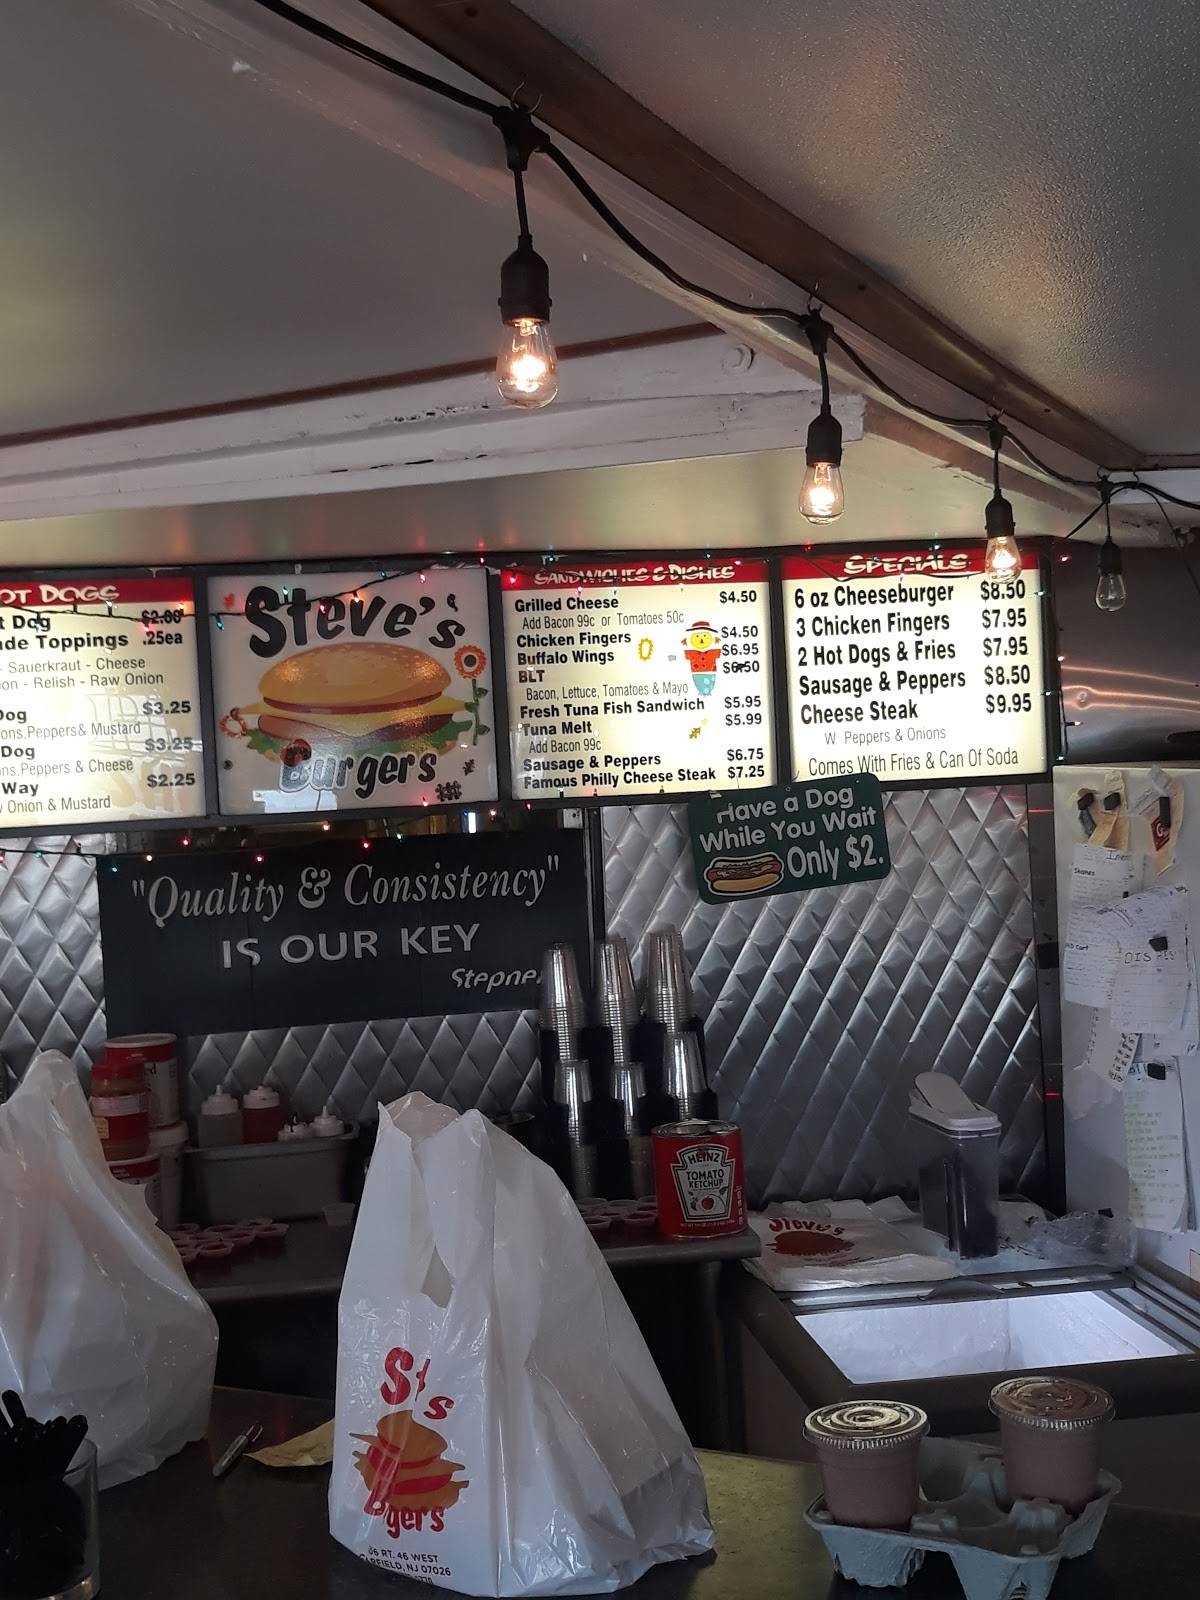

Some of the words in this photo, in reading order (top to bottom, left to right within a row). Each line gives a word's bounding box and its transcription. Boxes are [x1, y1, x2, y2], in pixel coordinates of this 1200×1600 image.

[719, 590, 757, 603] $4.50
[794, 588, 805, 608] 6
[811, 591, 828, 607] oz
[834, 584, 954, 607] Cheeseburger
[980, 579, 1026, 601] $8.50
[515, 599, 562, 613] Grilled
[569, 597, 619, 611] Cheese
[12, 614, 51, 632] Dog
[245, 585, 466, 658] Steve's
[523, 616, 542, 630] Add
[544, 615, 574, 629] Bacon
[577, 614, 595, 627] 99c
[601, 616, 610, 626] or
[617, 612, 664, 626] Tomatoes
[666, 610, 684, 624] 50c
[796, 617, 806, 637] 3
[812, 615, 881, 637] Chicken
[887, 612, 950, 636] Fingers
[981, 608, 1027, 629] $7.95
[517, 633, 575, 648] Chicken
[580, 631, 632, 647] Fingers
[721, 625, 758, 638] $4.50
[35, 631, 129, 651] Toppings
[982, 636, 1028, 658] $7.95
[518, 651, 568, 665] Buffalo
[572, 650, 615, 665] Wings
[721, 643, 759, 657] $6.95
[798, 647, 808, 667] 2
[814, 645, 842, 666] Hot
[849, 643, 890, 668] Dogs
[896, 641, 908, 662] &
[915, 640, 956, 661] Fries
[8, 659, 81, 674] Sauerkraut
[96, 657, 146, 670] Cheese
[34, 676, 75, 689] Relish
[90, 675, 120, 687] Raw
[125, 672, 164, 685] Onion
[518, 670, 545, 683] BLT
[984, 664, 1030, 686] $8.50
[526, 688, 559, 701] Bacon,
[562, 686, 599, 699] Lettuce,
[603, 684, 650, 697] Tomatoes
[652, 682, 660, 695] &
[663, 681, 688, 696] Mayo
[799, 675, 873, 698] Sausage
[879, 671, 891, 692] &
[897, 670, 966, 695] Peppers
[142, 701, 191, 716] $3.25
[520, 705, 560, 719] Fresh
[564, 703, 599, 717] Tuna
[604, 701, 632, 715] Fish
[637, 698, 705, 713] Sandwich
[724, 695, 762, 709] $5.95
[985, 693, 1032, 715] $9.95
[725, 713, 762, 727] $5.99
[801, 703, 864, 725] Cheese
[869, 699, 918, 721] Steak
[91, 720, 141, 735] Mustard
[522, 722, 557, 737] Tuna
[562, 721, 592, 735] Melt
[145, 738, 193, 751] $3.25
[529, 740, 548, 753] Add
[550, 739, 581, 752] Bacon
[583, 738, 602, 751] 99c
[824, 732, 836, 745] W
[844, 730, 890, 747] Peppers
[895, 728, 903, 742] &
[907, 727, 946, 741] Onions
[1, 745, 35, 760] Dog
[727, 748, 764, 762] $6.75
[75, 759, 84, 773] &
[88, 759, 134, 773] Cheese
[523, 757, 585, 773] Sausage
[589, 755, 599, 769] &
[604, 754, 661, 770] Peppers
[808, 758, 854, 776] Comes
[857, 755, 886, 773] With
[890, 753, 921, 772] Fries
[925, 752, 935, 770] &
[940, 750, 963, 769] Can
[968, 748, 982, 767] Of
[986, 747, 1019, 766] Soda
[524, 775, 578, 790] Famous
[582, 772, 619, 788] Philly
[623, 770, 673, 785] Cheese
[678, 768, 716, 781] Steak
[728, 765, 765, 779] $7.25
[1, 781, 39, 797] Way
[147, 774, 196, 788] $2.25
[8, 799, 43, 813] Onion
[47, 798, 57, 811] &
[61, 796, 111, 810] Mustard
[716, 800, 777, 825] Have
[783, 796, 799, 812] a
[805, 787, 854, 809] Dog
[699, 825, 766, 853] While
[770, 820, 816, 841] You
[822, 806, 877, 833] Wait
[787, 840, 839, 881] Only
[845, 834, 884, 871] $2.
[298, 867, 332, 908] &
[222, 937, 261, 969] IS
[280, 929, 378, 964] OUR
[400, 923, 480, 955] KEY
[687, 1152, 720, 1165] HEINZ
[686, 1169, 724, 1181] TOMATO
[688, 1179, 724, 1189] KETCHUP
[397, 1552, 409, 1561] 46
[410, 1553, 439, 1563] WEST
[407, 1563, 419, 1572] NJ
[421, 1565, 451, 1576] 07026
